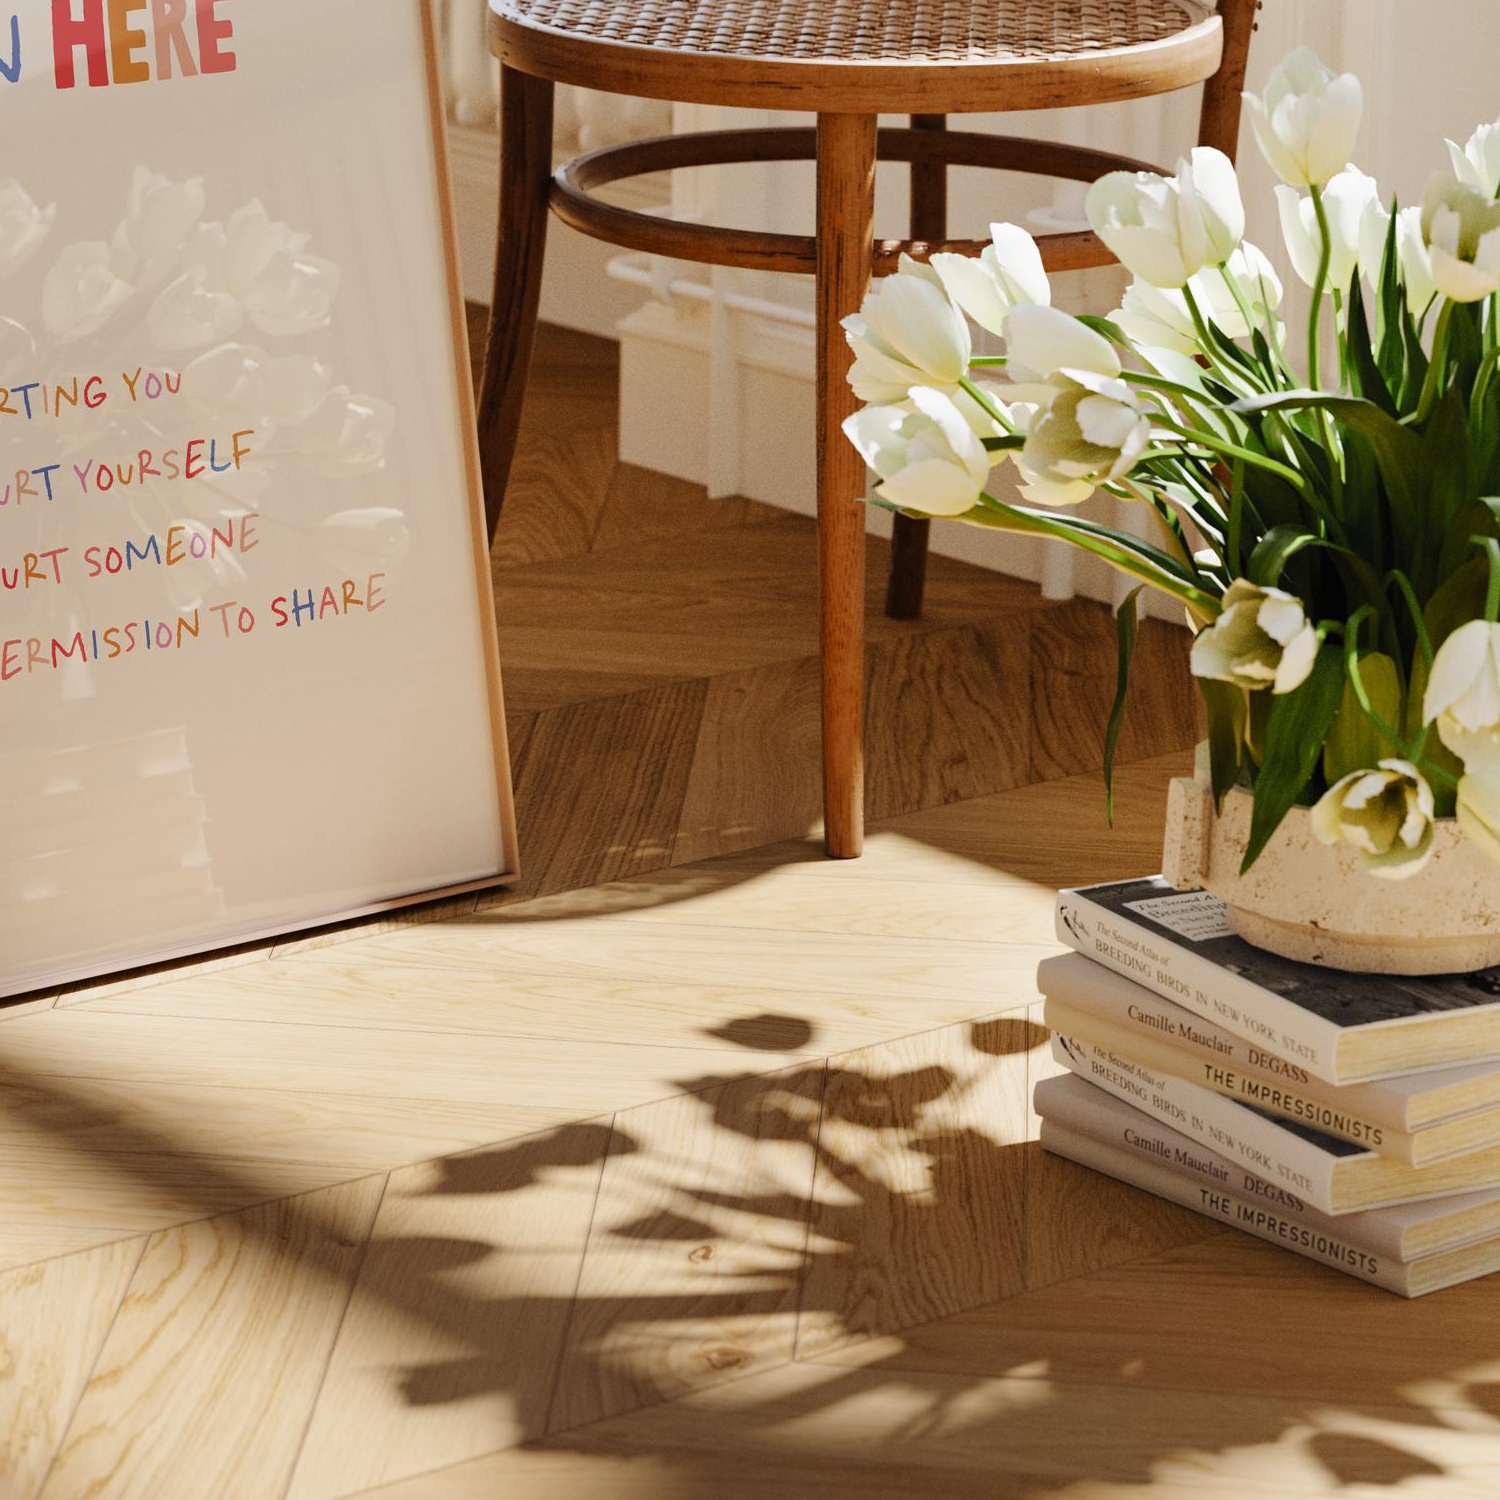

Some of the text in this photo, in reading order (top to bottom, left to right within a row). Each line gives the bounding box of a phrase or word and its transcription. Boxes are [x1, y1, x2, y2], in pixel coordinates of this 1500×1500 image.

[122, 367, 182, 401] YOU
[73, 430, 255, 494] YOURSELF
[83, 513, 260, 578] SOMEONE
[209, 601, 255, 635] TO
[270, 573, 386, 628] SHARE
[1097, 921, 1171, 967] The Second Atlas of
[1095, 939, 1318, 1064] BREEDING BIRDS IN NEW YORK STATE
[1093, 1046, 1166, 1092] The Second Atlas of
[1127, 1004, 1309, 1084] Camille Mauclair DEGASS
[1091, 1060, 1314, 1194] BREEDING BIRDS IN NEW YORK STATE
[1204, 1064, 1383, 1146] THE IMPRESSIONISTS
[1124, 1128, 1305, 1212] Camille Mauclair DEGASS
[1200, 1189, 1378, 1274] THE IMPRESSIONISTS
